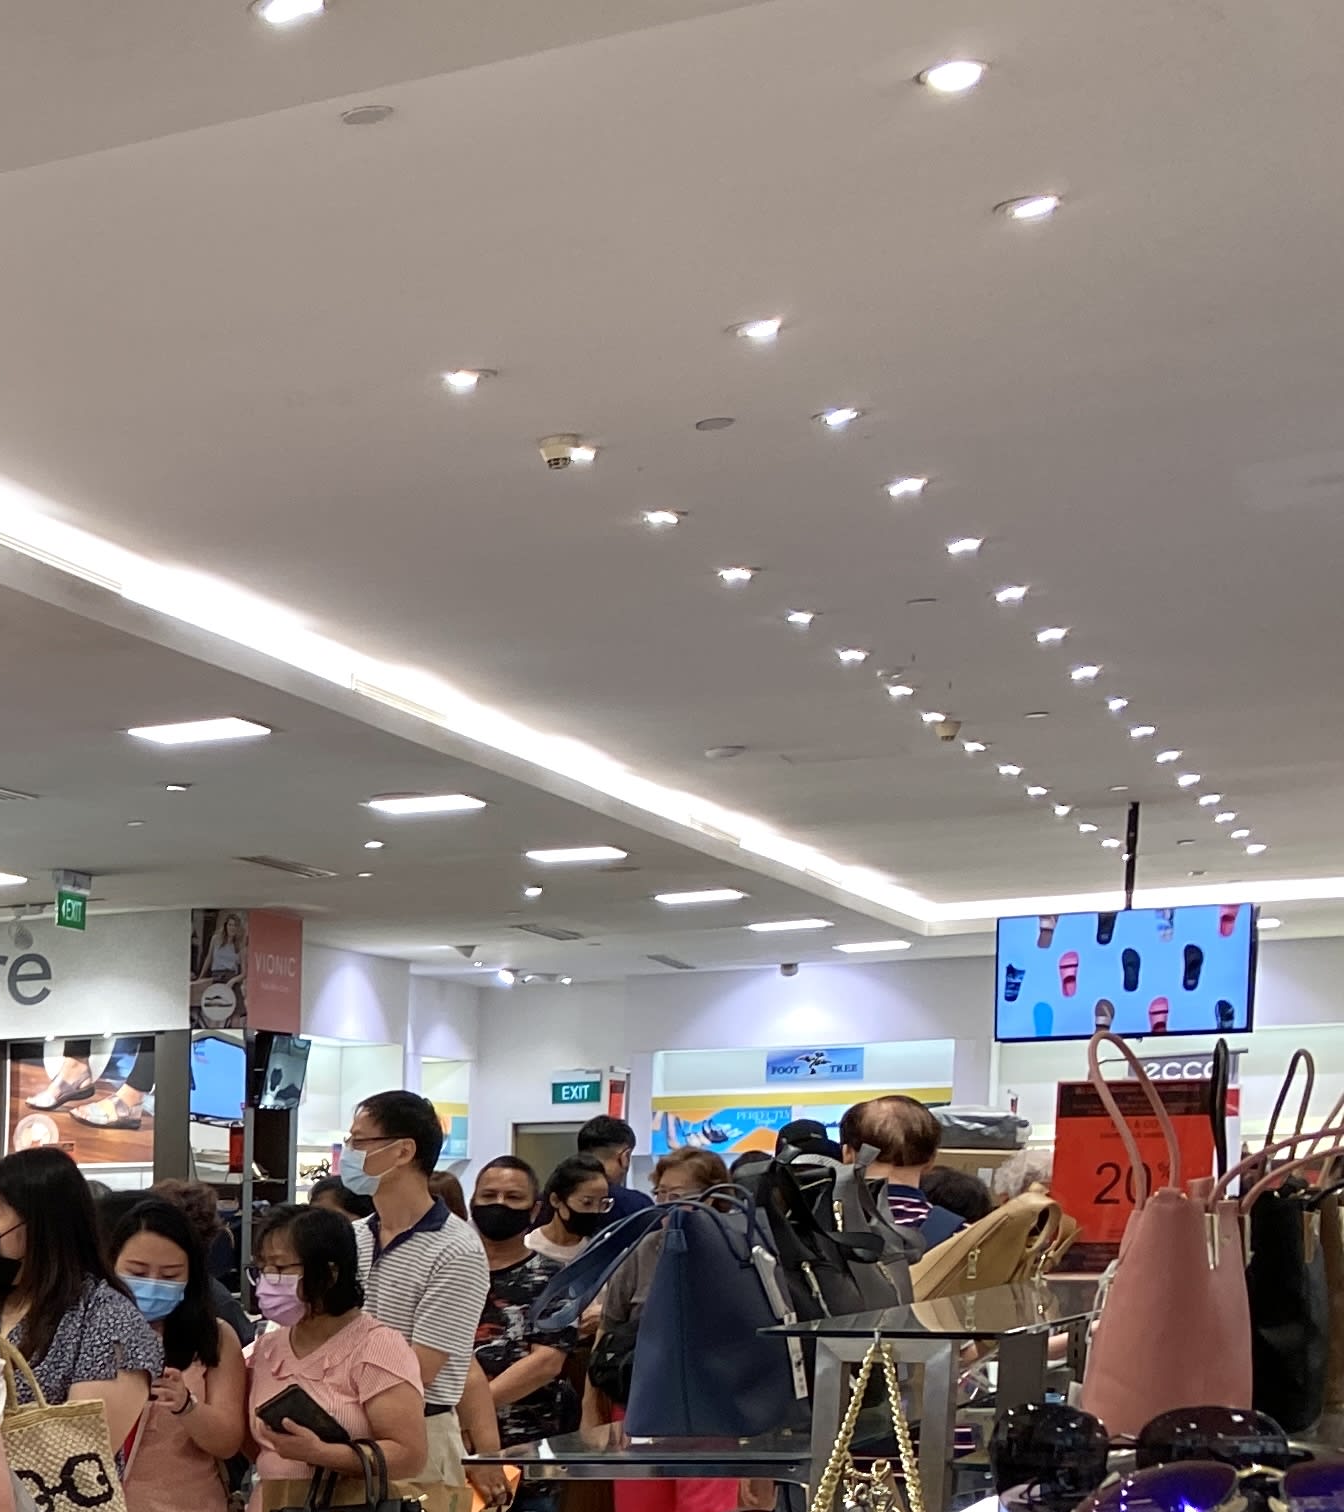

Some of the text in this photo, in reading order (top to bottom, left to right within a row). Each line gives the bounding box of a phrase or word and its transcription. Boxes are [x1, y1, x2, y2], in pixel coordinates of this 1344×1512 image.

[65, 899, 82, 922] EXIT
[254, 951, 297, 977] VIONIC
[770, 1063, 858, 1076] FOOT TREE
[561, 1084, 590, 1101] EXIT
